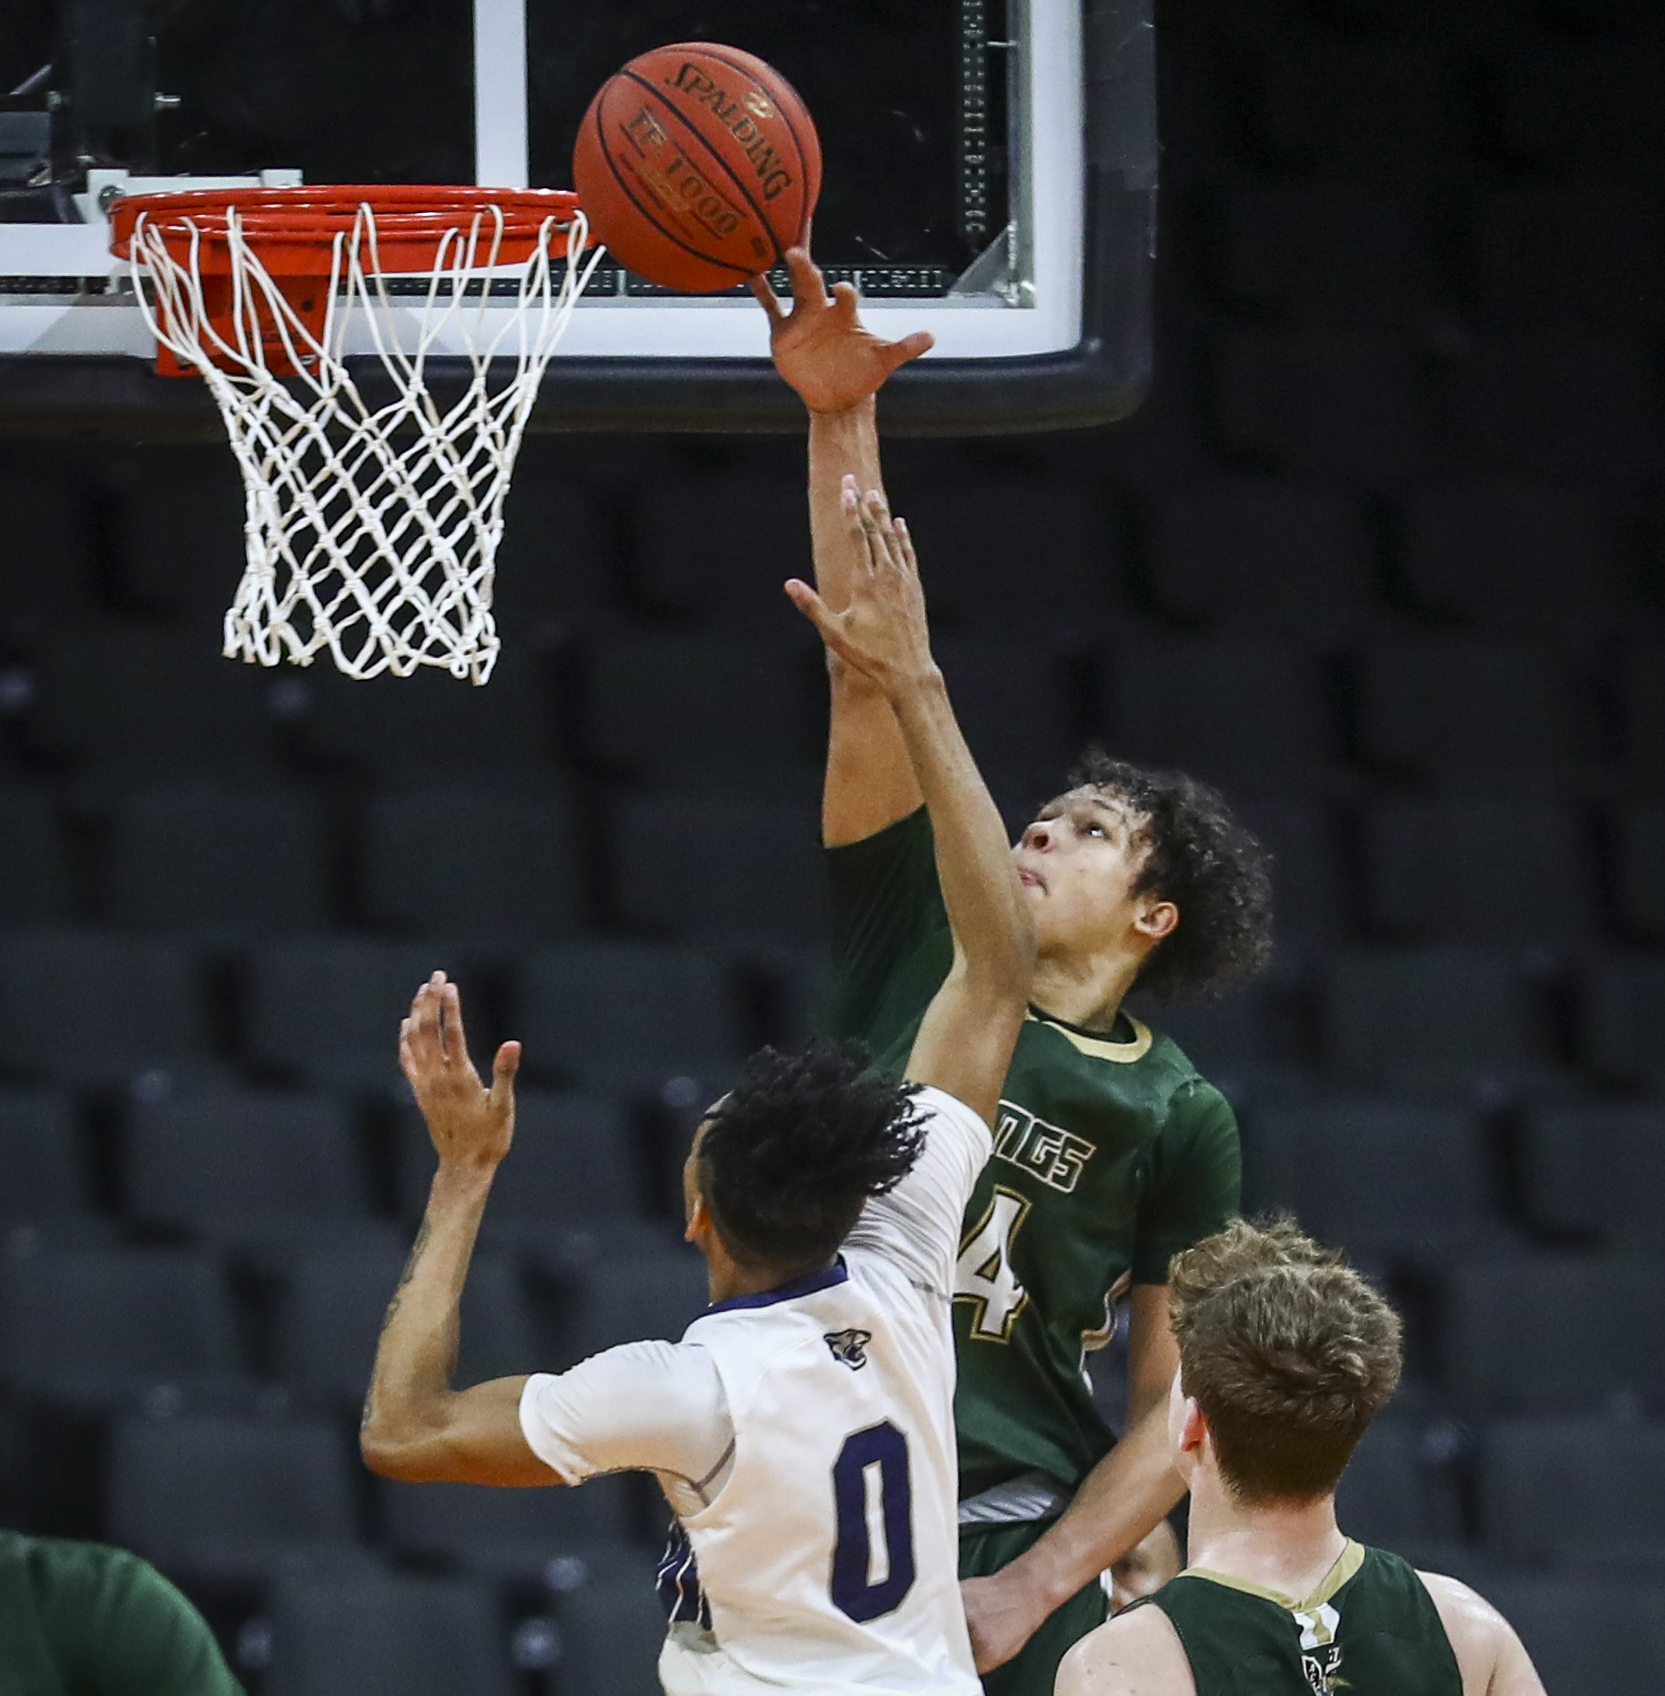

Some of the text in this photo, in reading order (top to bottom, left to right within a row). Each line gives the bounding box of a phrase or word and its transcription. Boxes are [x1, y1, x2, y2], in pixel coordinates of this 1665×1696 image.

[665, 63, 792, 200] SPALDING
[951, 1183, 1033, 1345] 4
[829, 1415, 918, 1626] 0
